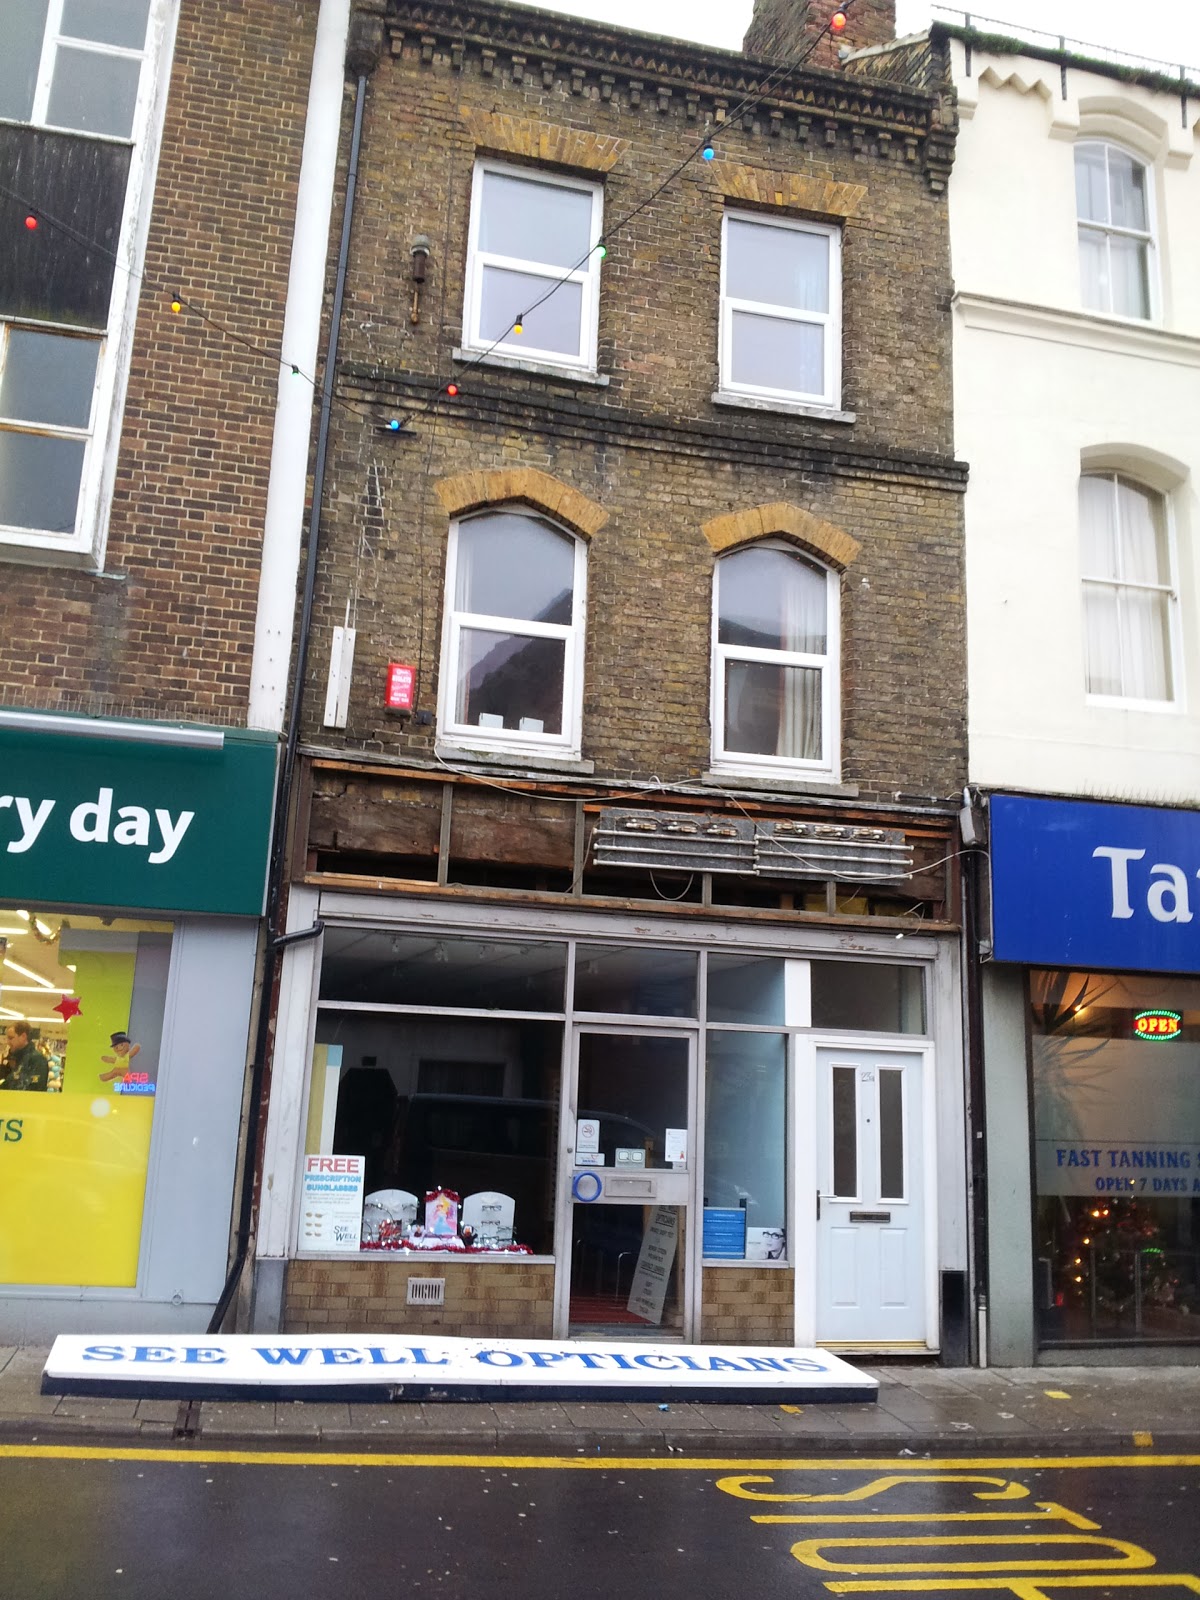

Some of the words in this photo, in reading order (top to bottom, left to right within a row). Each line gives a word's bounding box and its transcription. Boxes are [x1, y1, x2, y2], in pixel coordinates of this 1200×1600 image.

[69, 787, 195, 864] day
[1092, 846, 1200, 923] Ta
[1138, 1018, 1178, 1032] OPEN
[0, 1118, 23, 1142] S
[307, 1157, 360, 1173] FREE
[1056, 1149, 1101, 1167] FAST
[1106, 1150, 1190, 1168] TANNING
[304, 1174, 362, 1182] PRESCRIPTION
[1095, 1177, 1134, 1191] OPEN
[1140, 1178, 1148, 1191] 7
[1152, 1177, 1187, 1192] DAYS
[306, 1184, 358, 1192] SUNGLASSES
[82, 1345, 229, 1365] SEE
[251, 1347, 451, 1366] WELL
[475, 1350, 831, 1373] OPTICIANS
